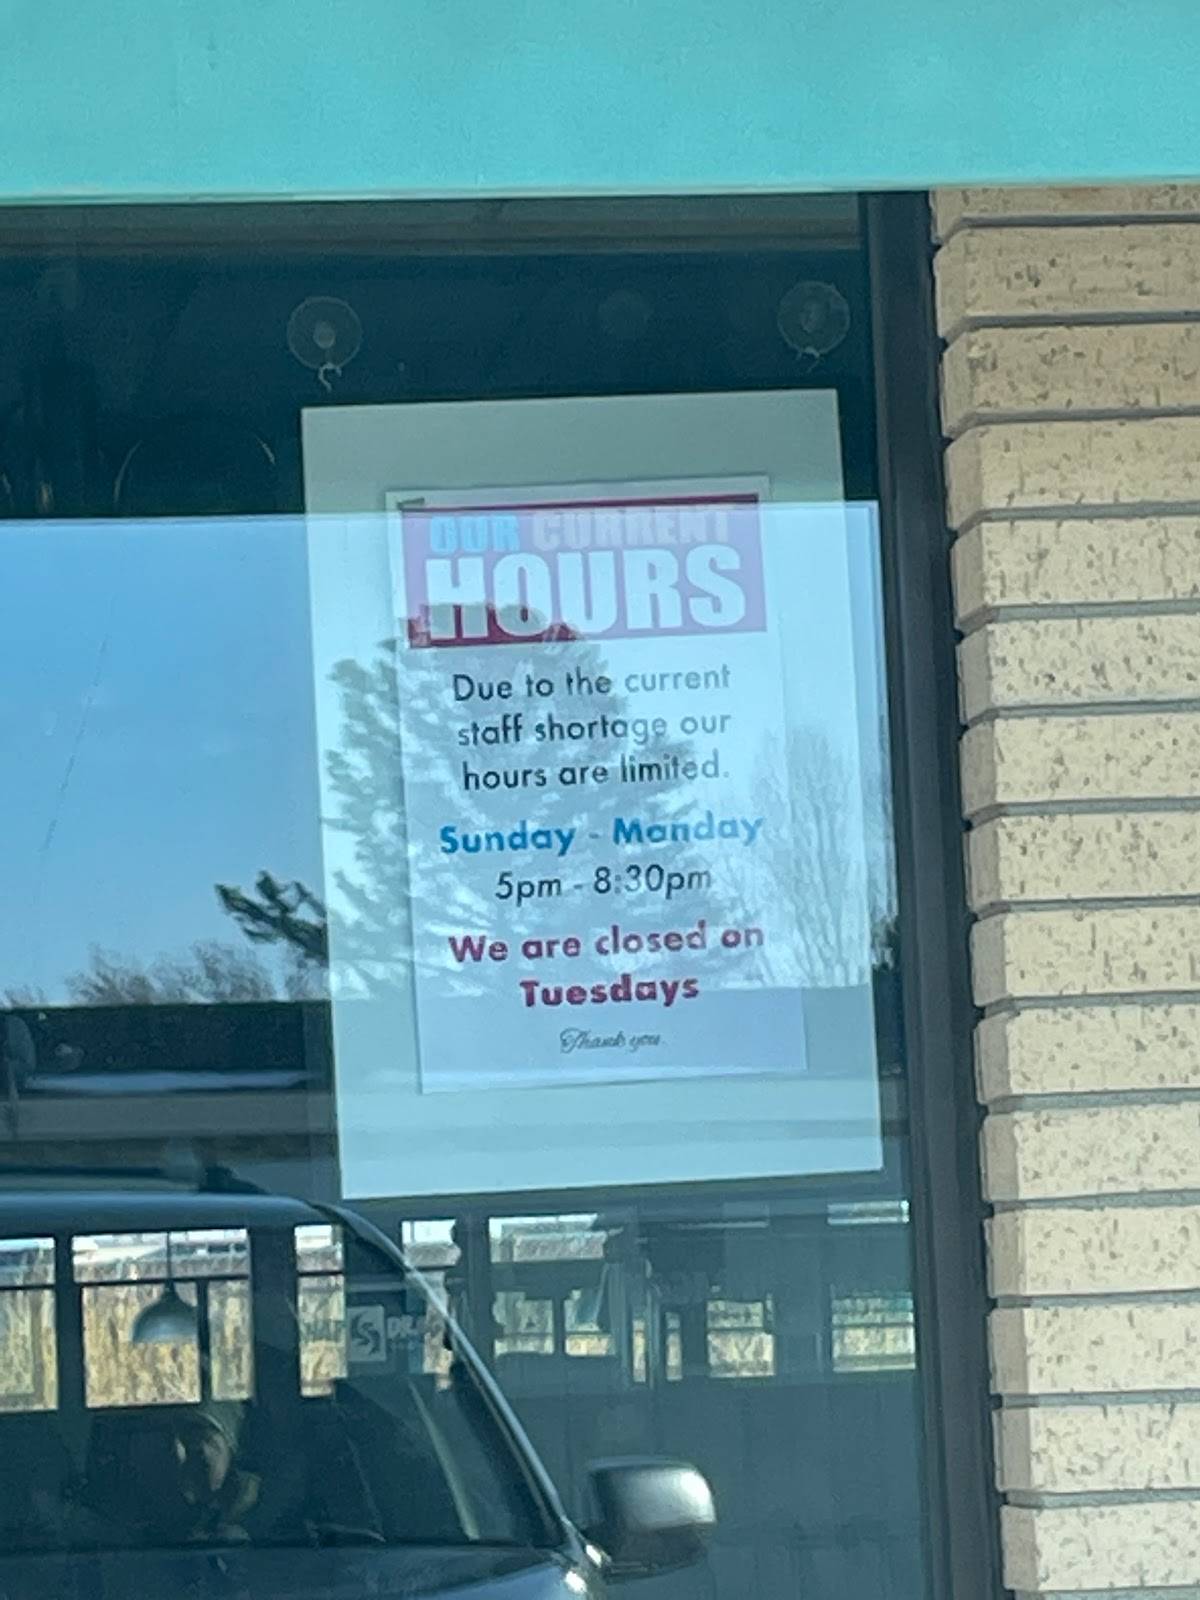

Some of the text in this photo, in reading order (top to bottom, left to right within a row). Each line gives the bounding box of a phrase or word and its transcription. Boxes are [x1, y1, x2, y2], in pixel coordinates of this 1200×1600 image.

[430, 504, 733, 553] OUR CURRENT
[426, 544, 746, 640] HOURS
[453, 664, 732, 702] Due to the current
[457, 713, 732, 746] staff shortage our
[462, 749, 730, 791] hours are limited.
[439, 820, 577, 857] Sunday
[495, 871, 562, 907] 5pm
[593, 863, 712, 899] 8:30pm
[448, 920, 766, 963] We are closed on
[519, 973, 700, 1008] Tuesdays
[559, 1027, 627, 1054] Thank
